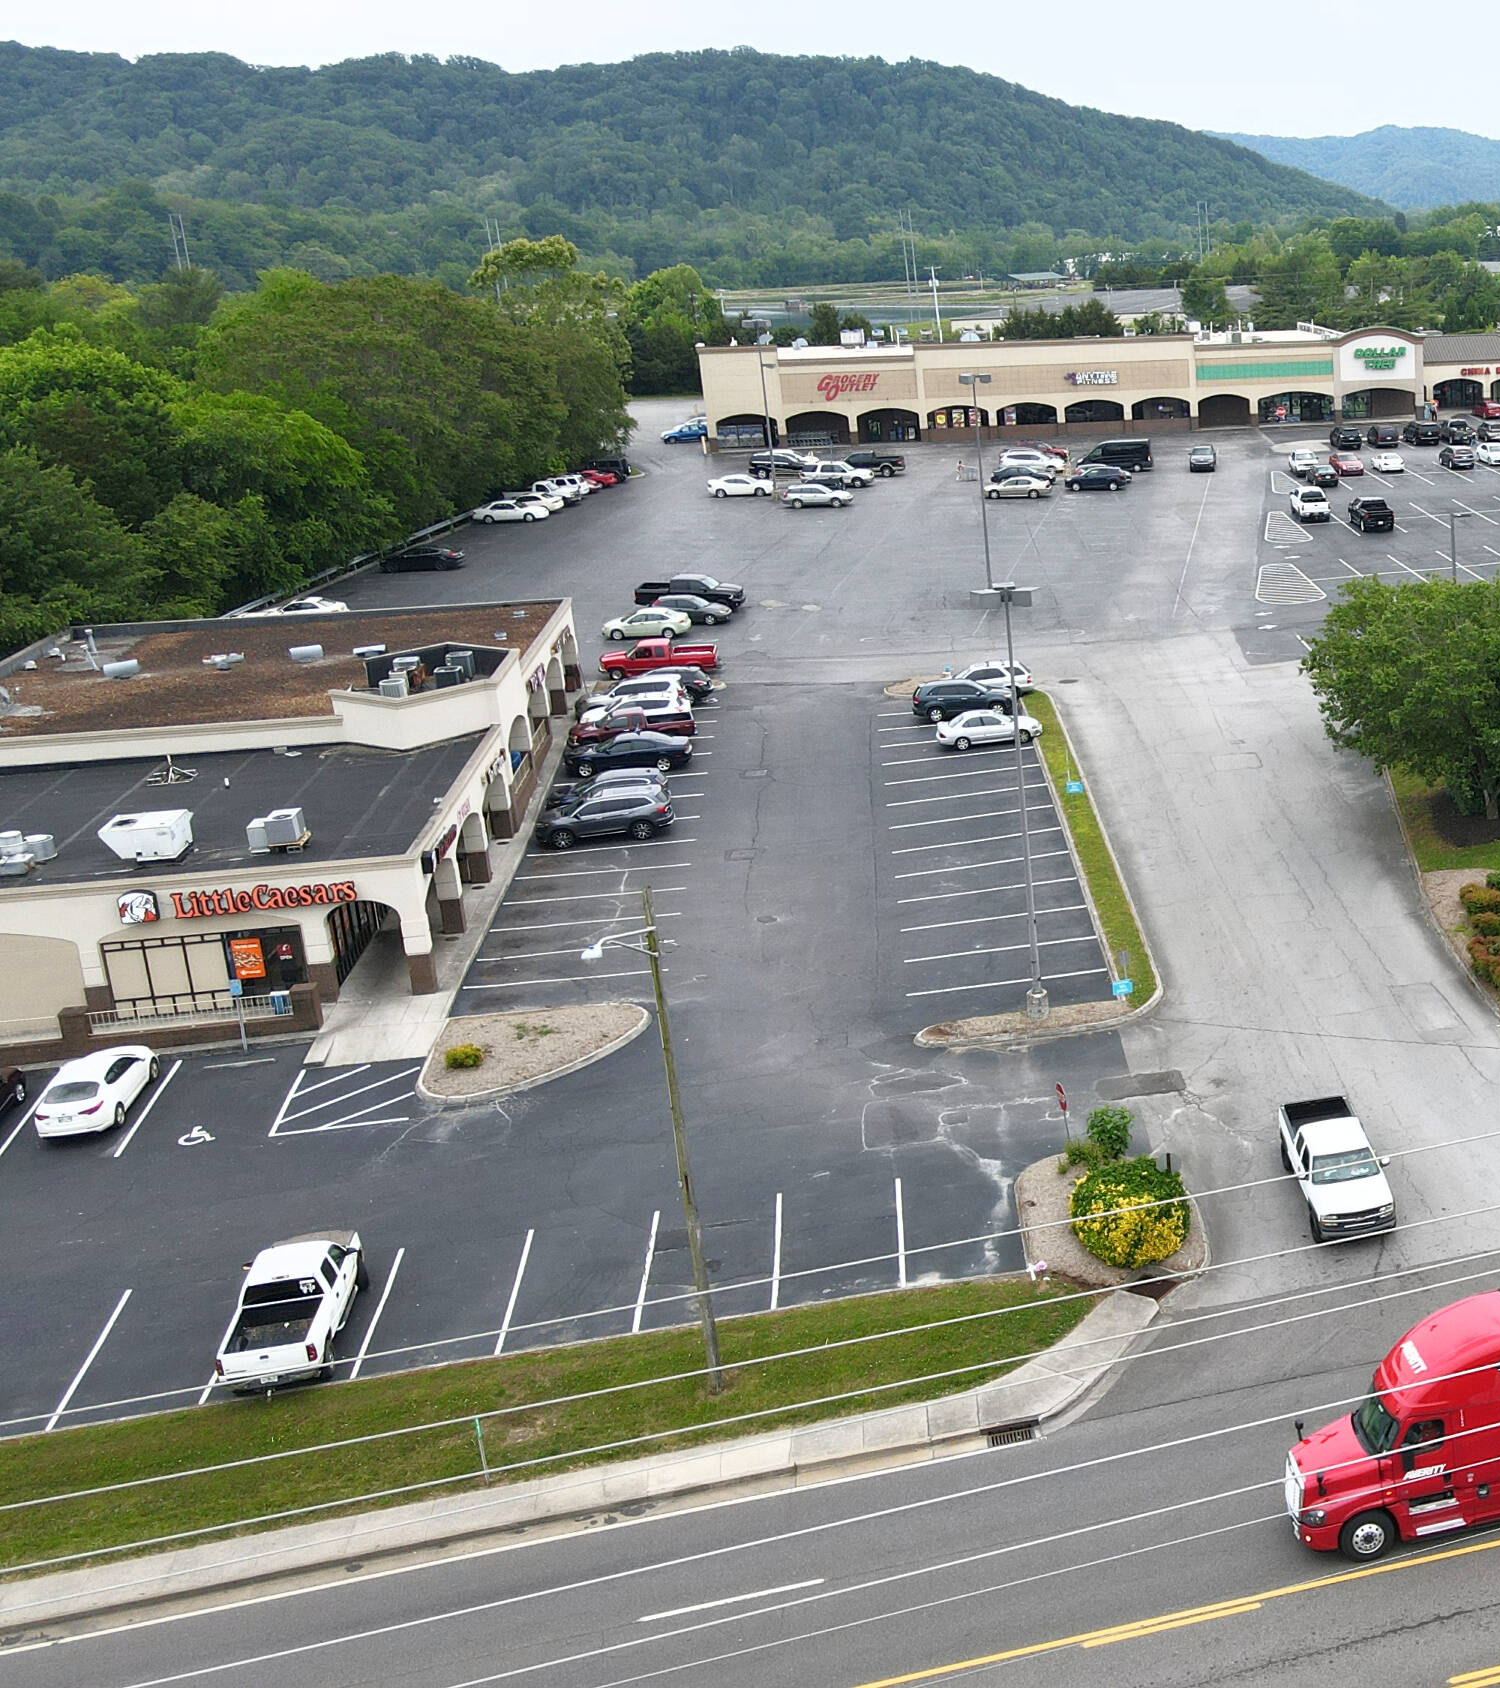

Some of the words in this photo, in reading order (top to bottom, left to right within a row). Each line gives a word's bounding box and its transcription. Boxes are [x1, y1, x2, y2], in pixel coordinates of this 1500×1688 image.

[1354, 346, 1407, 359] DOLLAR
[817, 373, 880, 392] GROCERY
[825, 383, 877, 401] OUTLET
[170, 887, 251, 919] Little
[251, 880, 357, 911] Caesars
